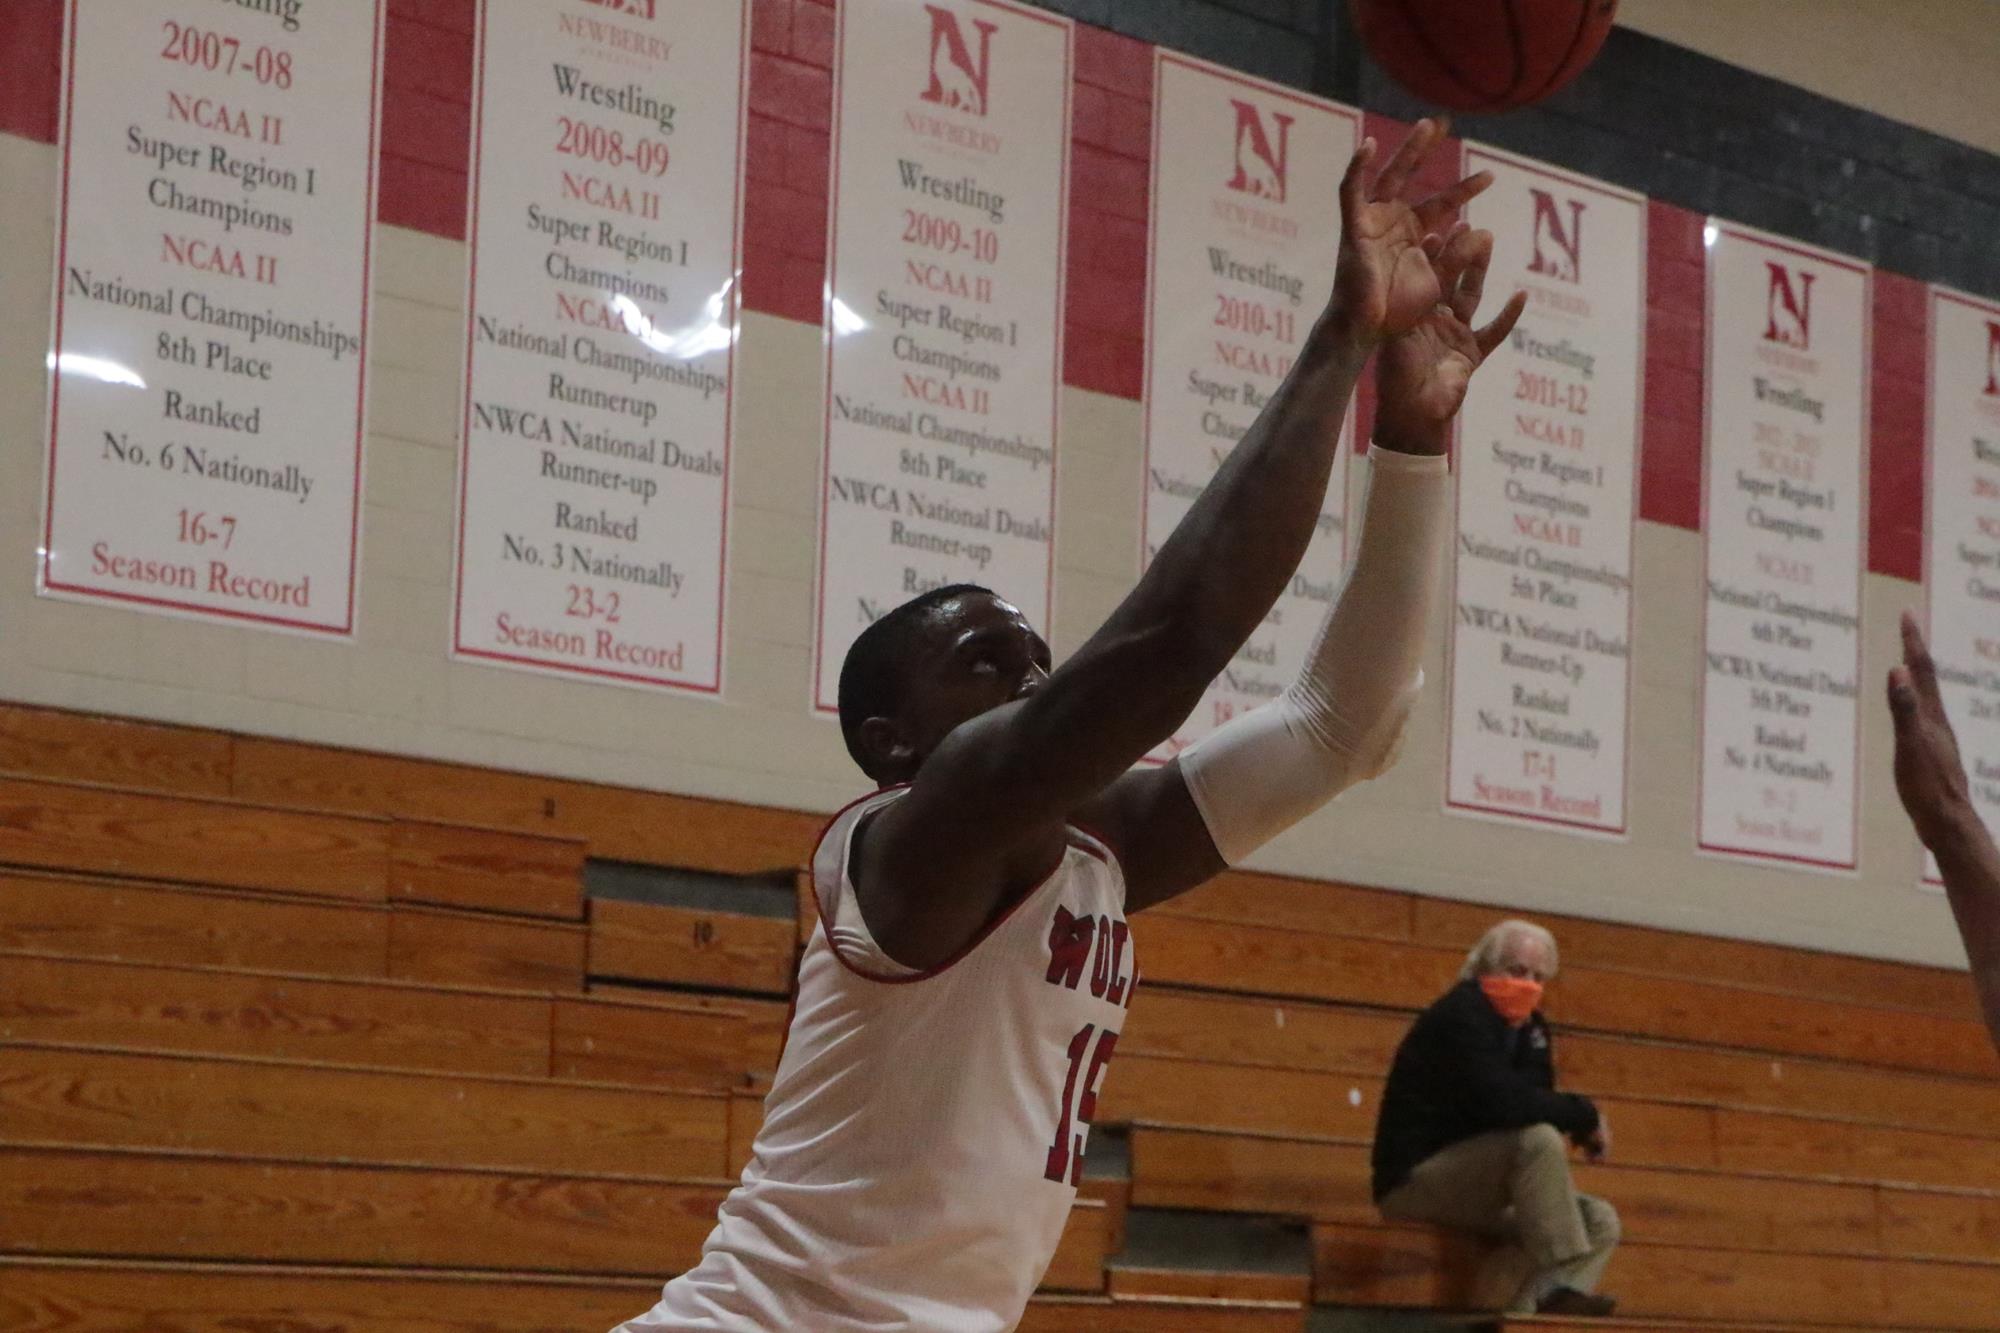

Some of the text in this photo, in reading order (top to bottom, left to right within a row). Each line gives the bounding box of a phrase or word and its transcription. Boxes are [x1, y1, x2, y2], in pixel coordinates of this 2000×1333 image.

[162, 20, 293, 90] 2007-08
[168, 91, 252, 138] NCAA
[553, 63, 676, 135] Wrestling
[127, 126, 200, 170] Super
[209, 145, 298, 193] Region
[556, 117, 669, 177] 2008-09
[148, 178, 293, 236] Champions
[562, 171, 633, 216] NCAA
[898, 159, 1004, 224] Wrestling
[162, 234, 246, 278] NCAA
[527, 203, 591, 244] Super
[599, 221, 672, 262] Region
[902, 209, 998, 264] 2009-10
[546, 252, 669, 303] Champions
[906, 260, 968, 298] NCAA
[1207, 246, 1304, 307] Wrestling
[68, 267, 359, 360] National Championships
[877, 289, 931, 328] Super
[938, 305, 1005, 345] Region
[1214, 293, 1296, 344] 2010-11
[157, 331, 272, 380] 8th Place
[477, 316, 726, 398] National Championships
[893, 335, 1001, 382] Champions
[1215, 340, 1272, 377] NCAA
[164, 390, 260, 434] Ranked
[549, 373, 658, 427] Runnerup
[903, 373, 966, 410] NCAA
[1188, 368, 1238, 405] Super
[473, 403, 722, 477] NWCA National Duals
[835, 395, 1052, 470] National Championships
[103, 431, 313, 502] No. 6 Nationally
[541, 452, 657, 504] Runner-up
[936, 456, 987, 489] Place
[177, 508, 236, 550] 16-7
[555, 502, 638, 542] Ranked
[831, 475, 900, 514] NWCA
[908, 492, 991, 532] National
[503, 534, 684, 598] No. 3 Nationally
[891, 519, 991, 568] Runner-up
[92, 542, 310, 607] Season Record
[566, 584, 621, 623] 23-2
[496, 612, 683, 672] Season Record
